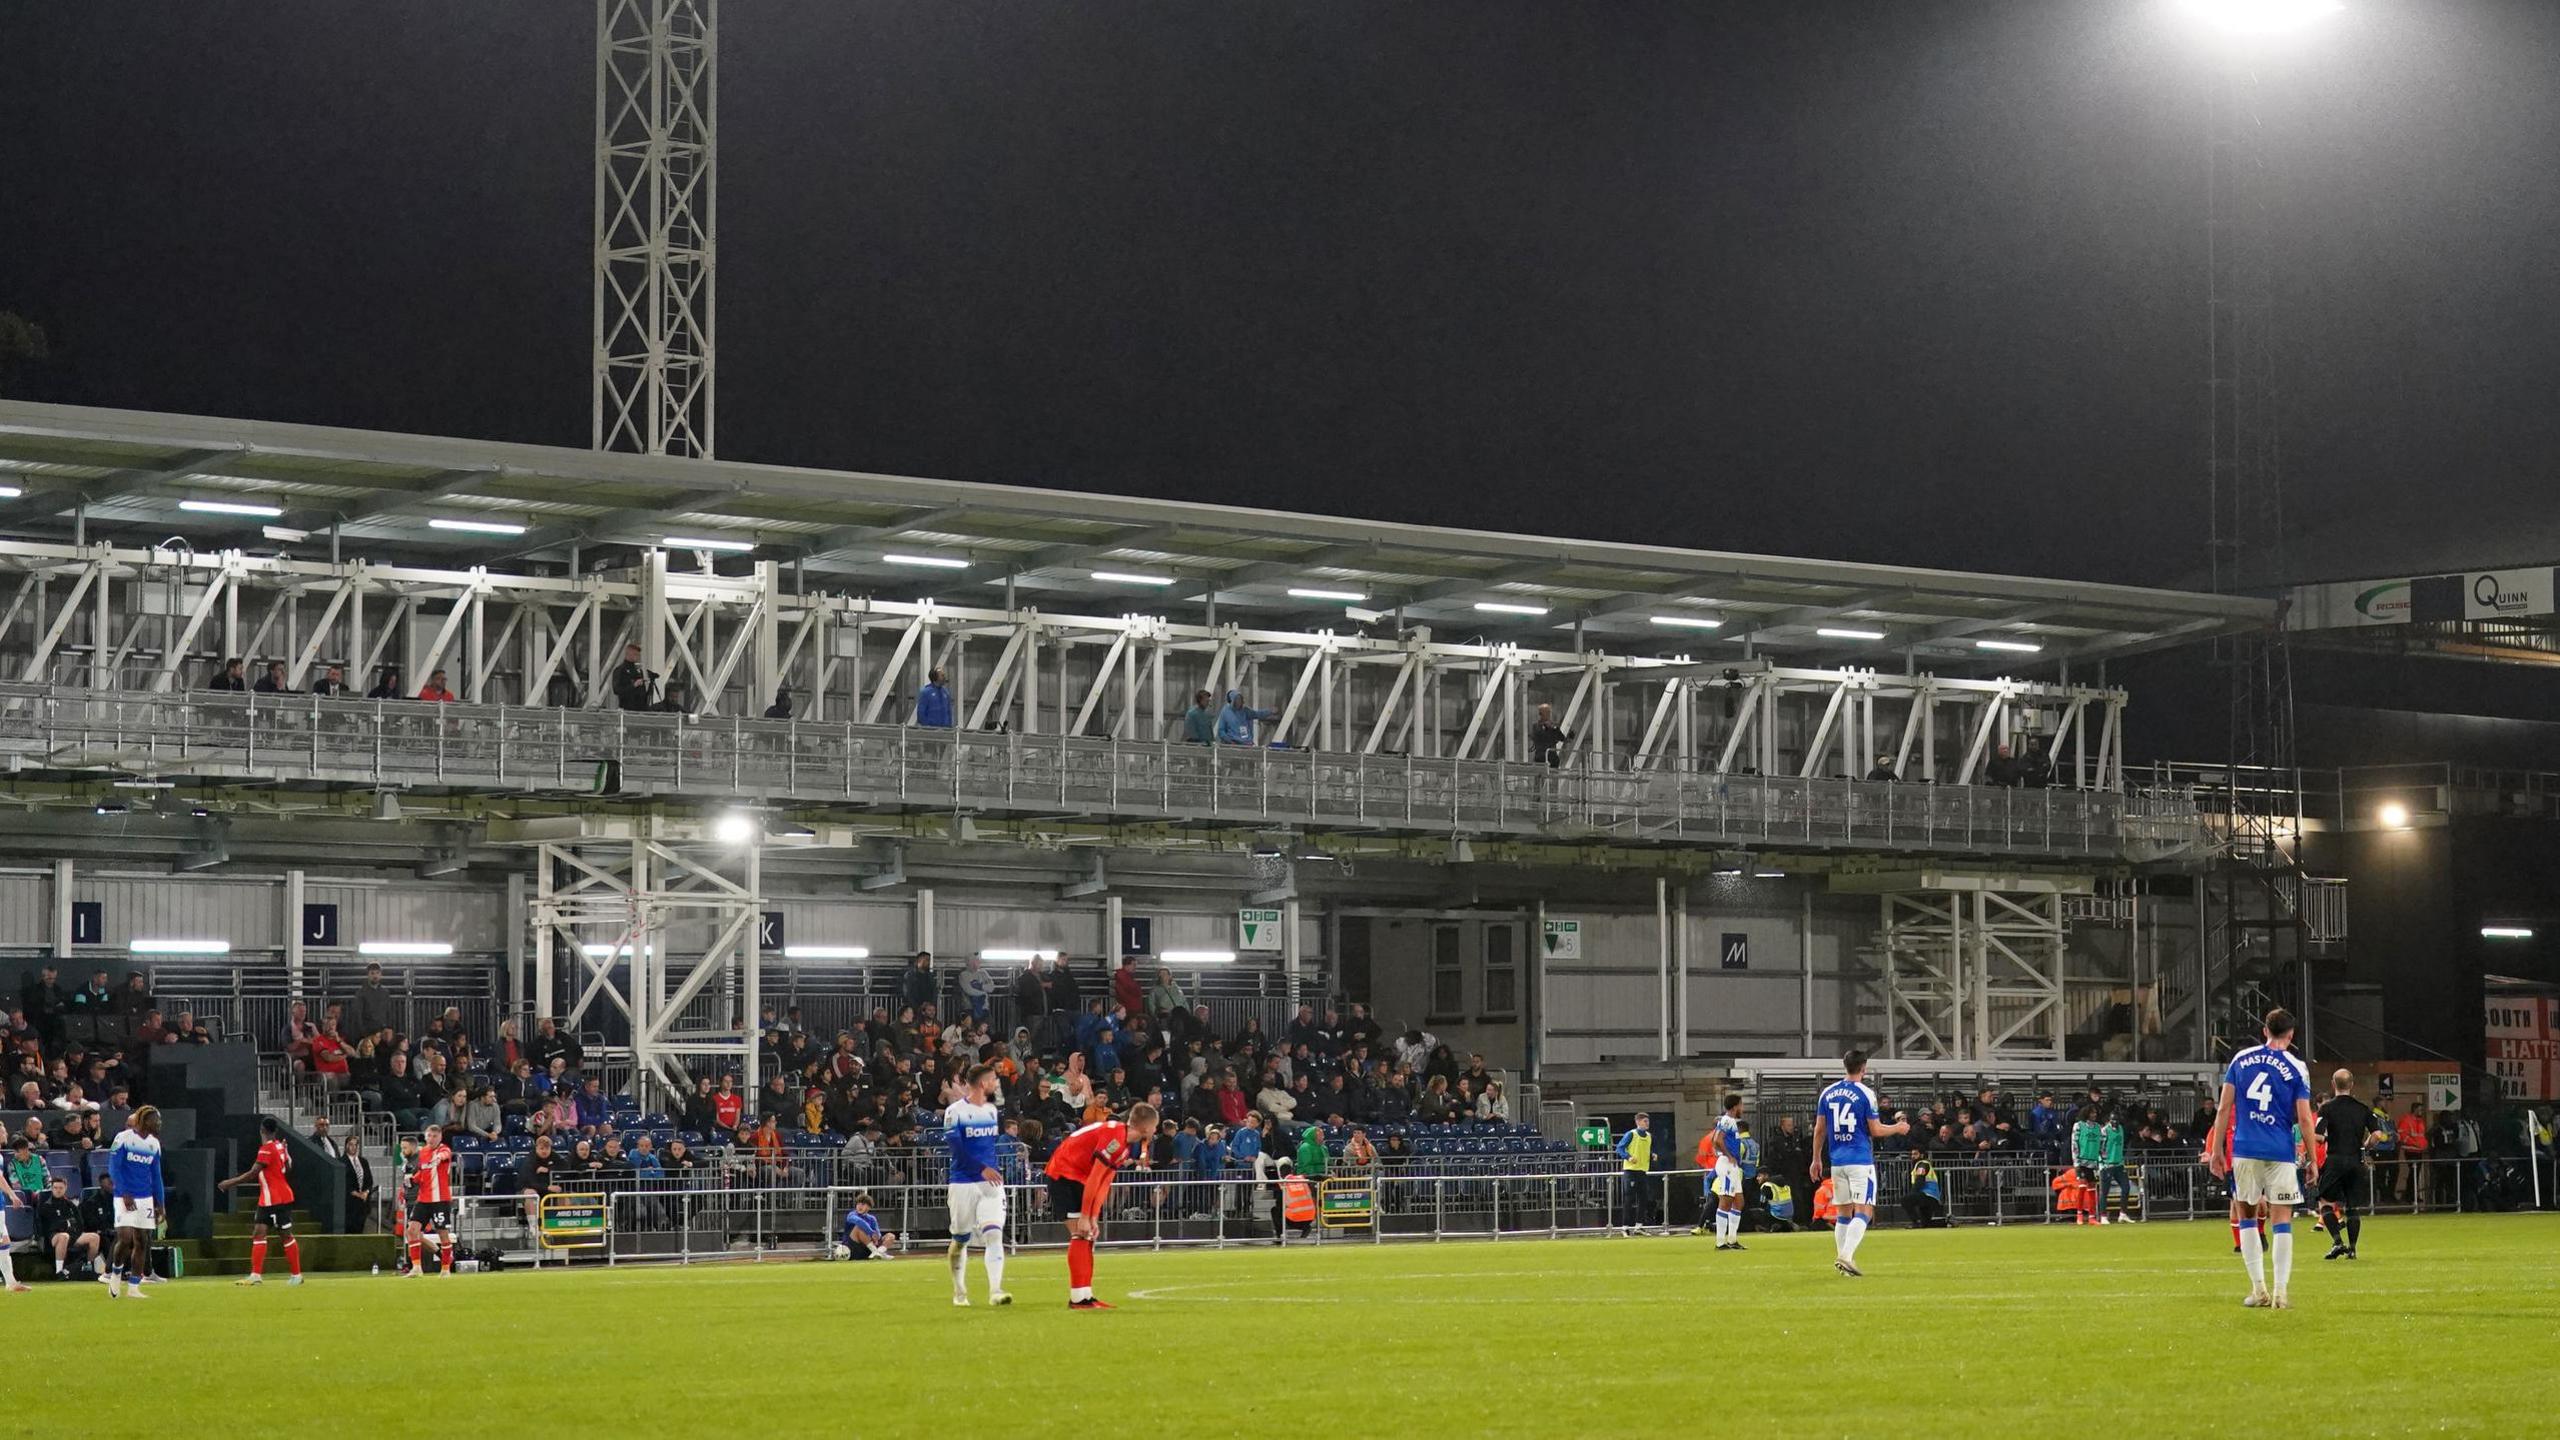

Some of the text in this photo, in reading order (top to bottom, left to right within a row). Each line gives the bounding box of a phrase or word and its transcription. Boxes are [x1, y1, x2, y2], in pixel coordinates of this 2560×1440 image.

[2474, 575, 2528, 611] QUINN
[80, 913, 84, 938] I
[312, 914, 324, 939] J
[761, 921, 774, 944] K
[1131, 927, 1141, 949] L
[1265, 928, 1273, 943] 5
[1566, 938, 1573, 952] 5
[1726, 942, 1745, 962] M
[2240, 1055, 2293, 1081] MASTERSON
[2246, 1071, 2273, 1112] 4
[1828, 1102, 1857, 1133] 14
